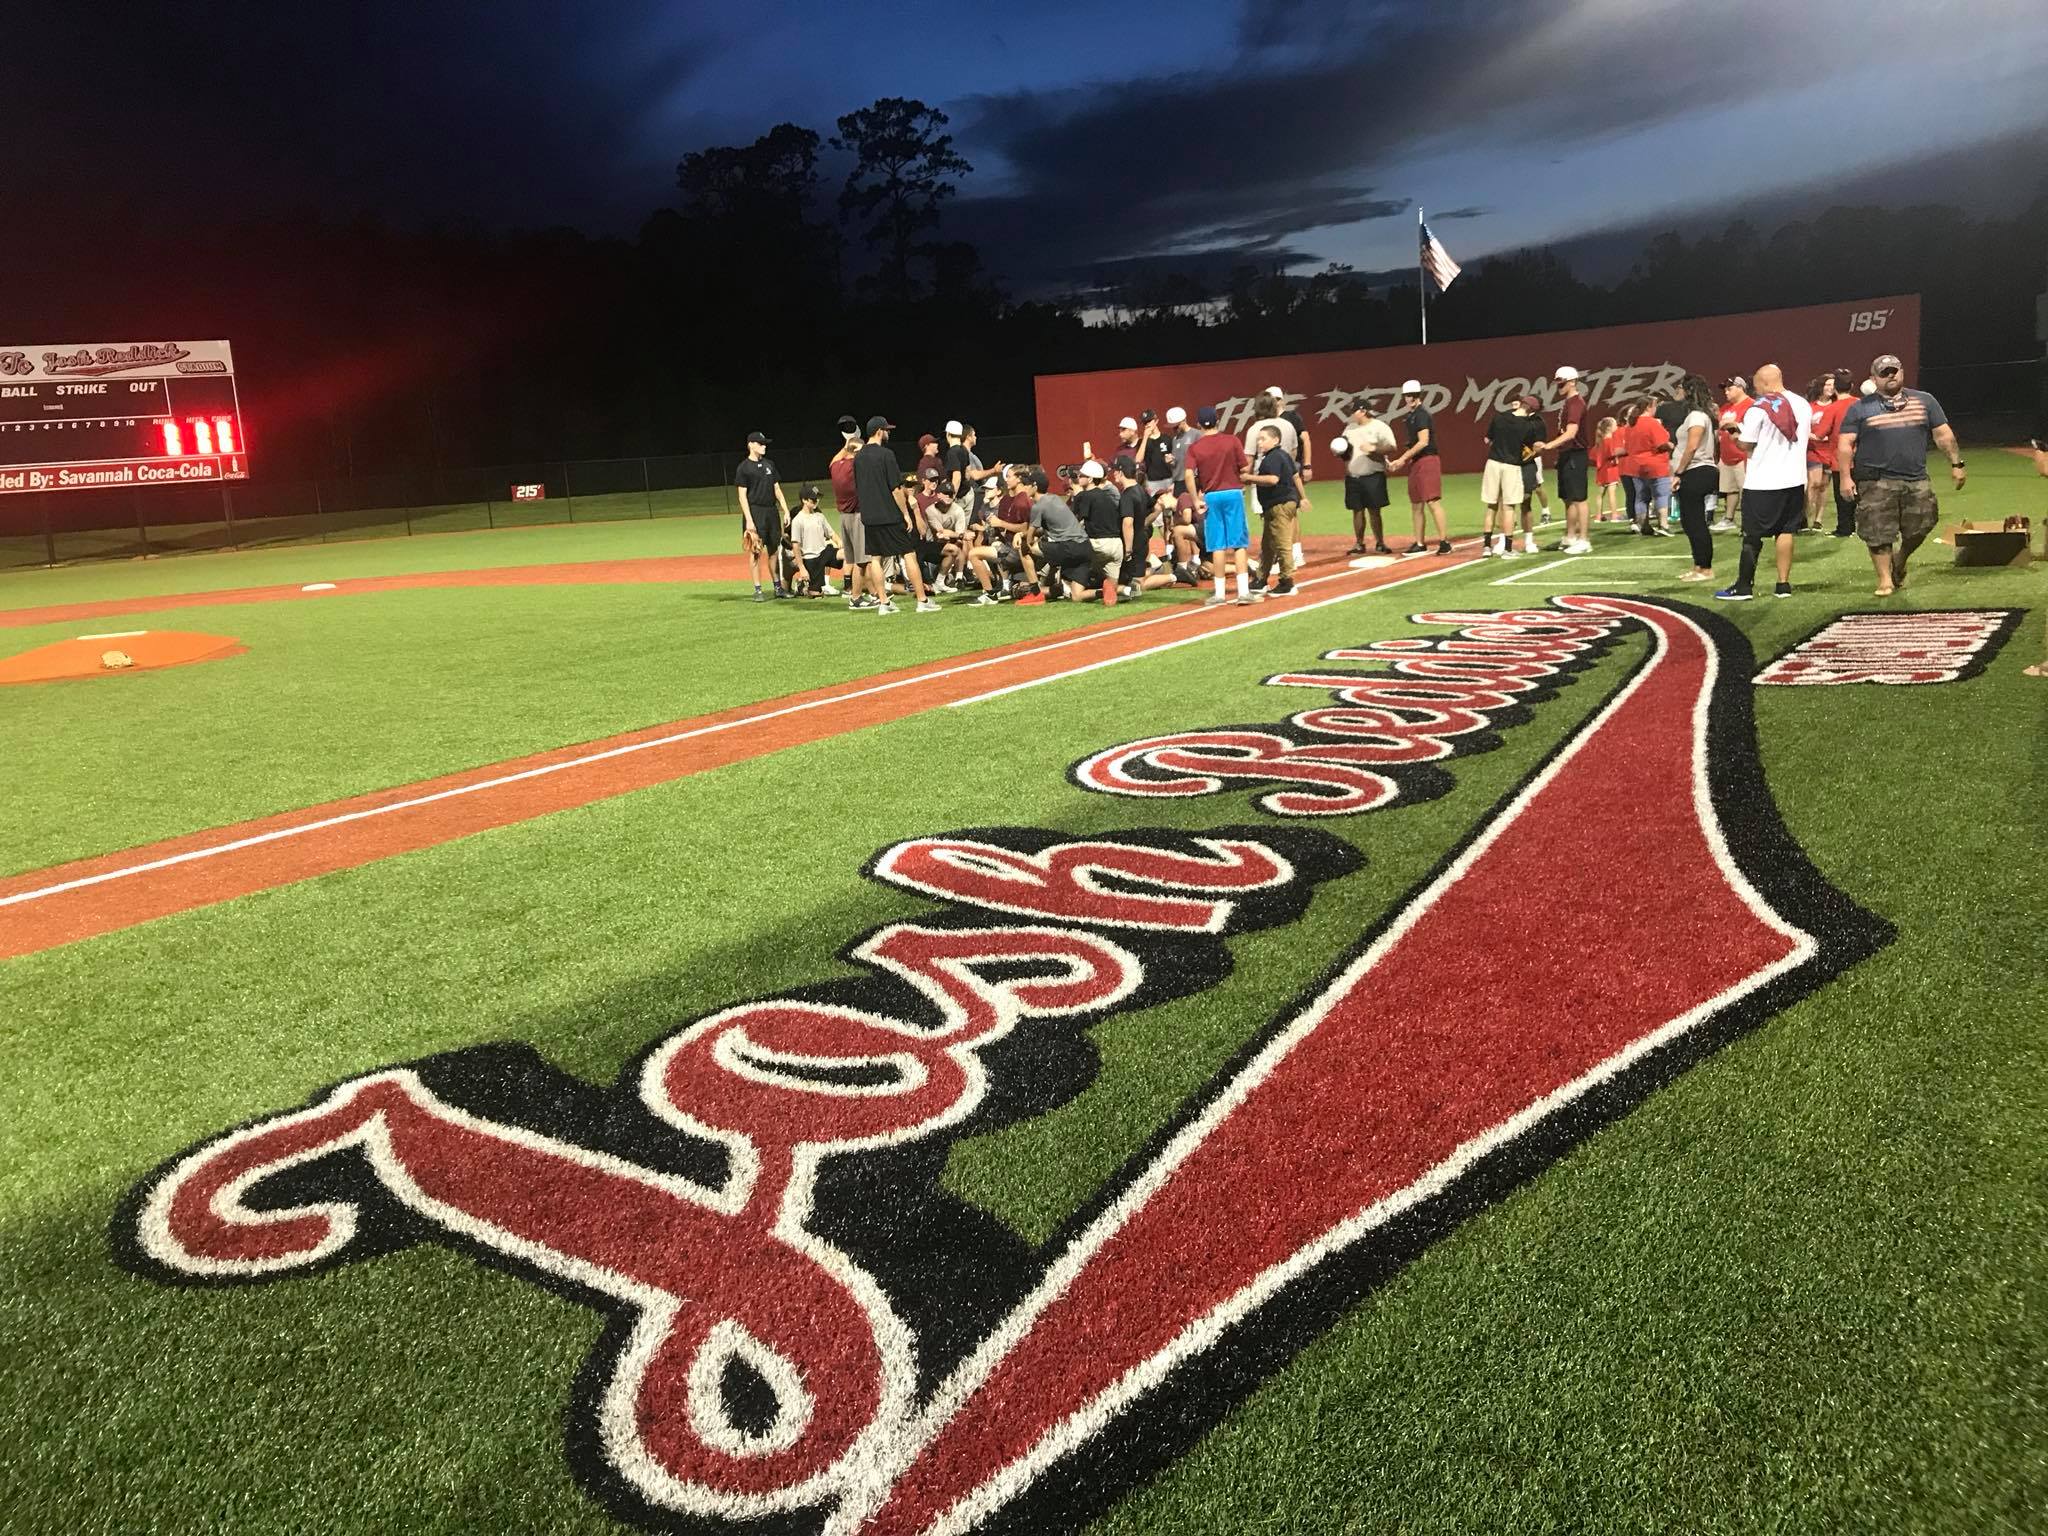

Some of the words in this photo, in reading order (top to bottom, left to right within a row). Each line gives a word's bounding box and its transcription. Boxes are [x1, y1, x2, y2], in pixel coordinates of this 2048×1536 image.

[1849, 309, 1895, 332] 195'
[42, 350, 94, 374] Josh
[95, 343, 180, 364] Reddick
[1, 387, 38, 398] BALL
[56, 384, 108, 395] STRIKE
[129, 382, 157, 392] OUT
[30, 471, 54, 489] By:
[58, 466, 133, 485] Savannah
[137, 462, 212, 480] Coca-Cola
[516, 484, 541, 498] 215'
[136, 833, 1294, 1522] Josh
[1075, 609, 1623, 817] Reddick
